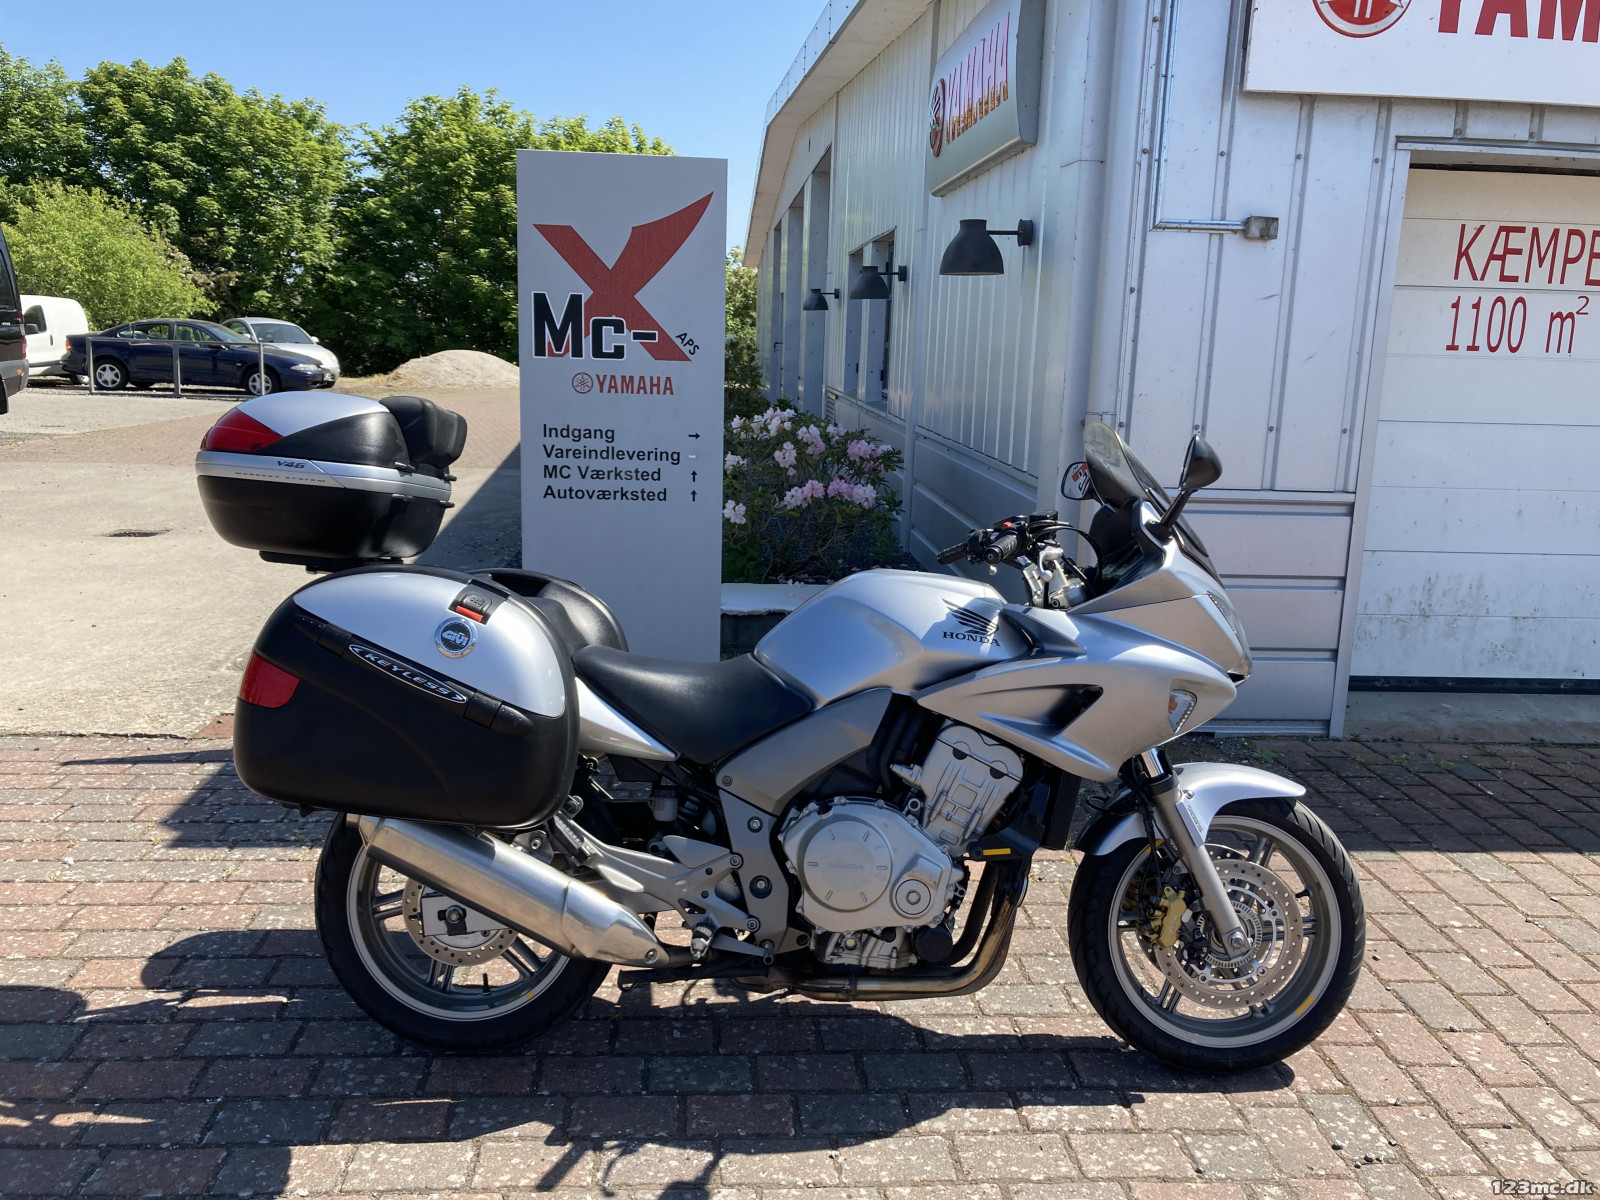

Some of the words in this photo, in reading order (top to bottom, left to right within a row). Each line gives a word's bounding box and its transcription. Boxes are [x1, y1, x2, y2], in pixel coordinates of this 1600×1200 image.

[1445, 295, 1527, 353] 1100
[675, 332, 700, 356] APS
[595, 374, 674, 395] YAMAHA
[542, 423, 615, 443] Indgang
[542, 444, 681, 465] Vareindlevering
[543, 464, 571, 479] MC
[577, 465, 661, 481] Værksted
[542, 485, 667, 501] Autoværksted
[942, 631, 1001, 647] HONDA
[364, 653, 451, 695] KEYLESS
